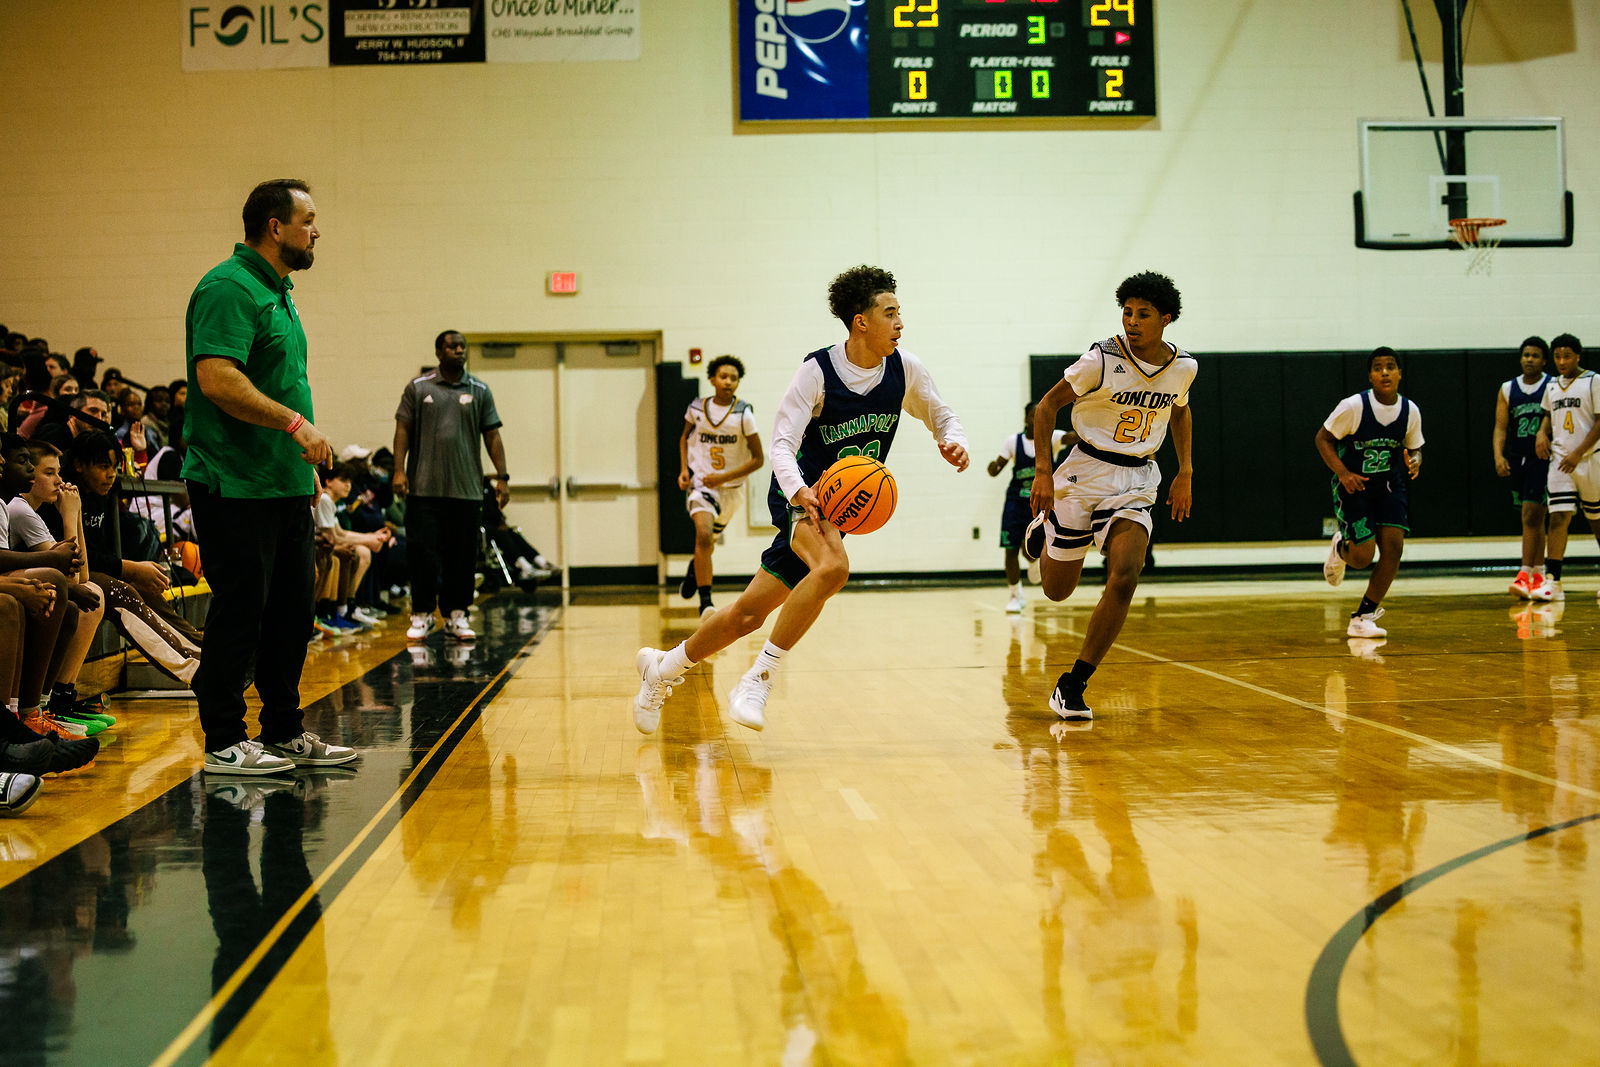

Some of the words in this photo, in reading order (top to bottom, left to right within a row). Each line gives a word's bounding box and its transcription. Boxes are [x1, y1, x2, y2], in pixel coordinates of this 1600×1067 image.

[491, 0, 541, 17] Once
[543, 0, 561, 16] a
[893, 0, 939, 28] 23
[1090, 0, 1135, 26] 24
[189, 4, 325, 47] FOIL'S
[356, 23, 378, 33] NEW
[380, 22, 459, 32] CONSTRUCTION
[959, 23, 1018, 38] PERIOD
[1026, 15, 1046, 44] 3
[356, 39, 390, 50] JERRY
[406, 37, 455, 49] HUDSON,
[893, 56, 934, 69] FOULS
[969, 56, 1055, 68] PLAYER-FOUL
[1090, 55, 1131, 67] FOULS
[908, 70, 928, 100] 0
[1105, 69, 1124, 98] 2
[891, 101, 938, 113] POINTS
[971, 101, 1018, 113] MATCH
[1089, 100, 1135, 112] POINTS
[1563, 411, 1575, 434] 4
[710, 446, 725, 470] 5
[1362, 448, 1391, 474] 22
[833, 489, 873, 527] Wilson
